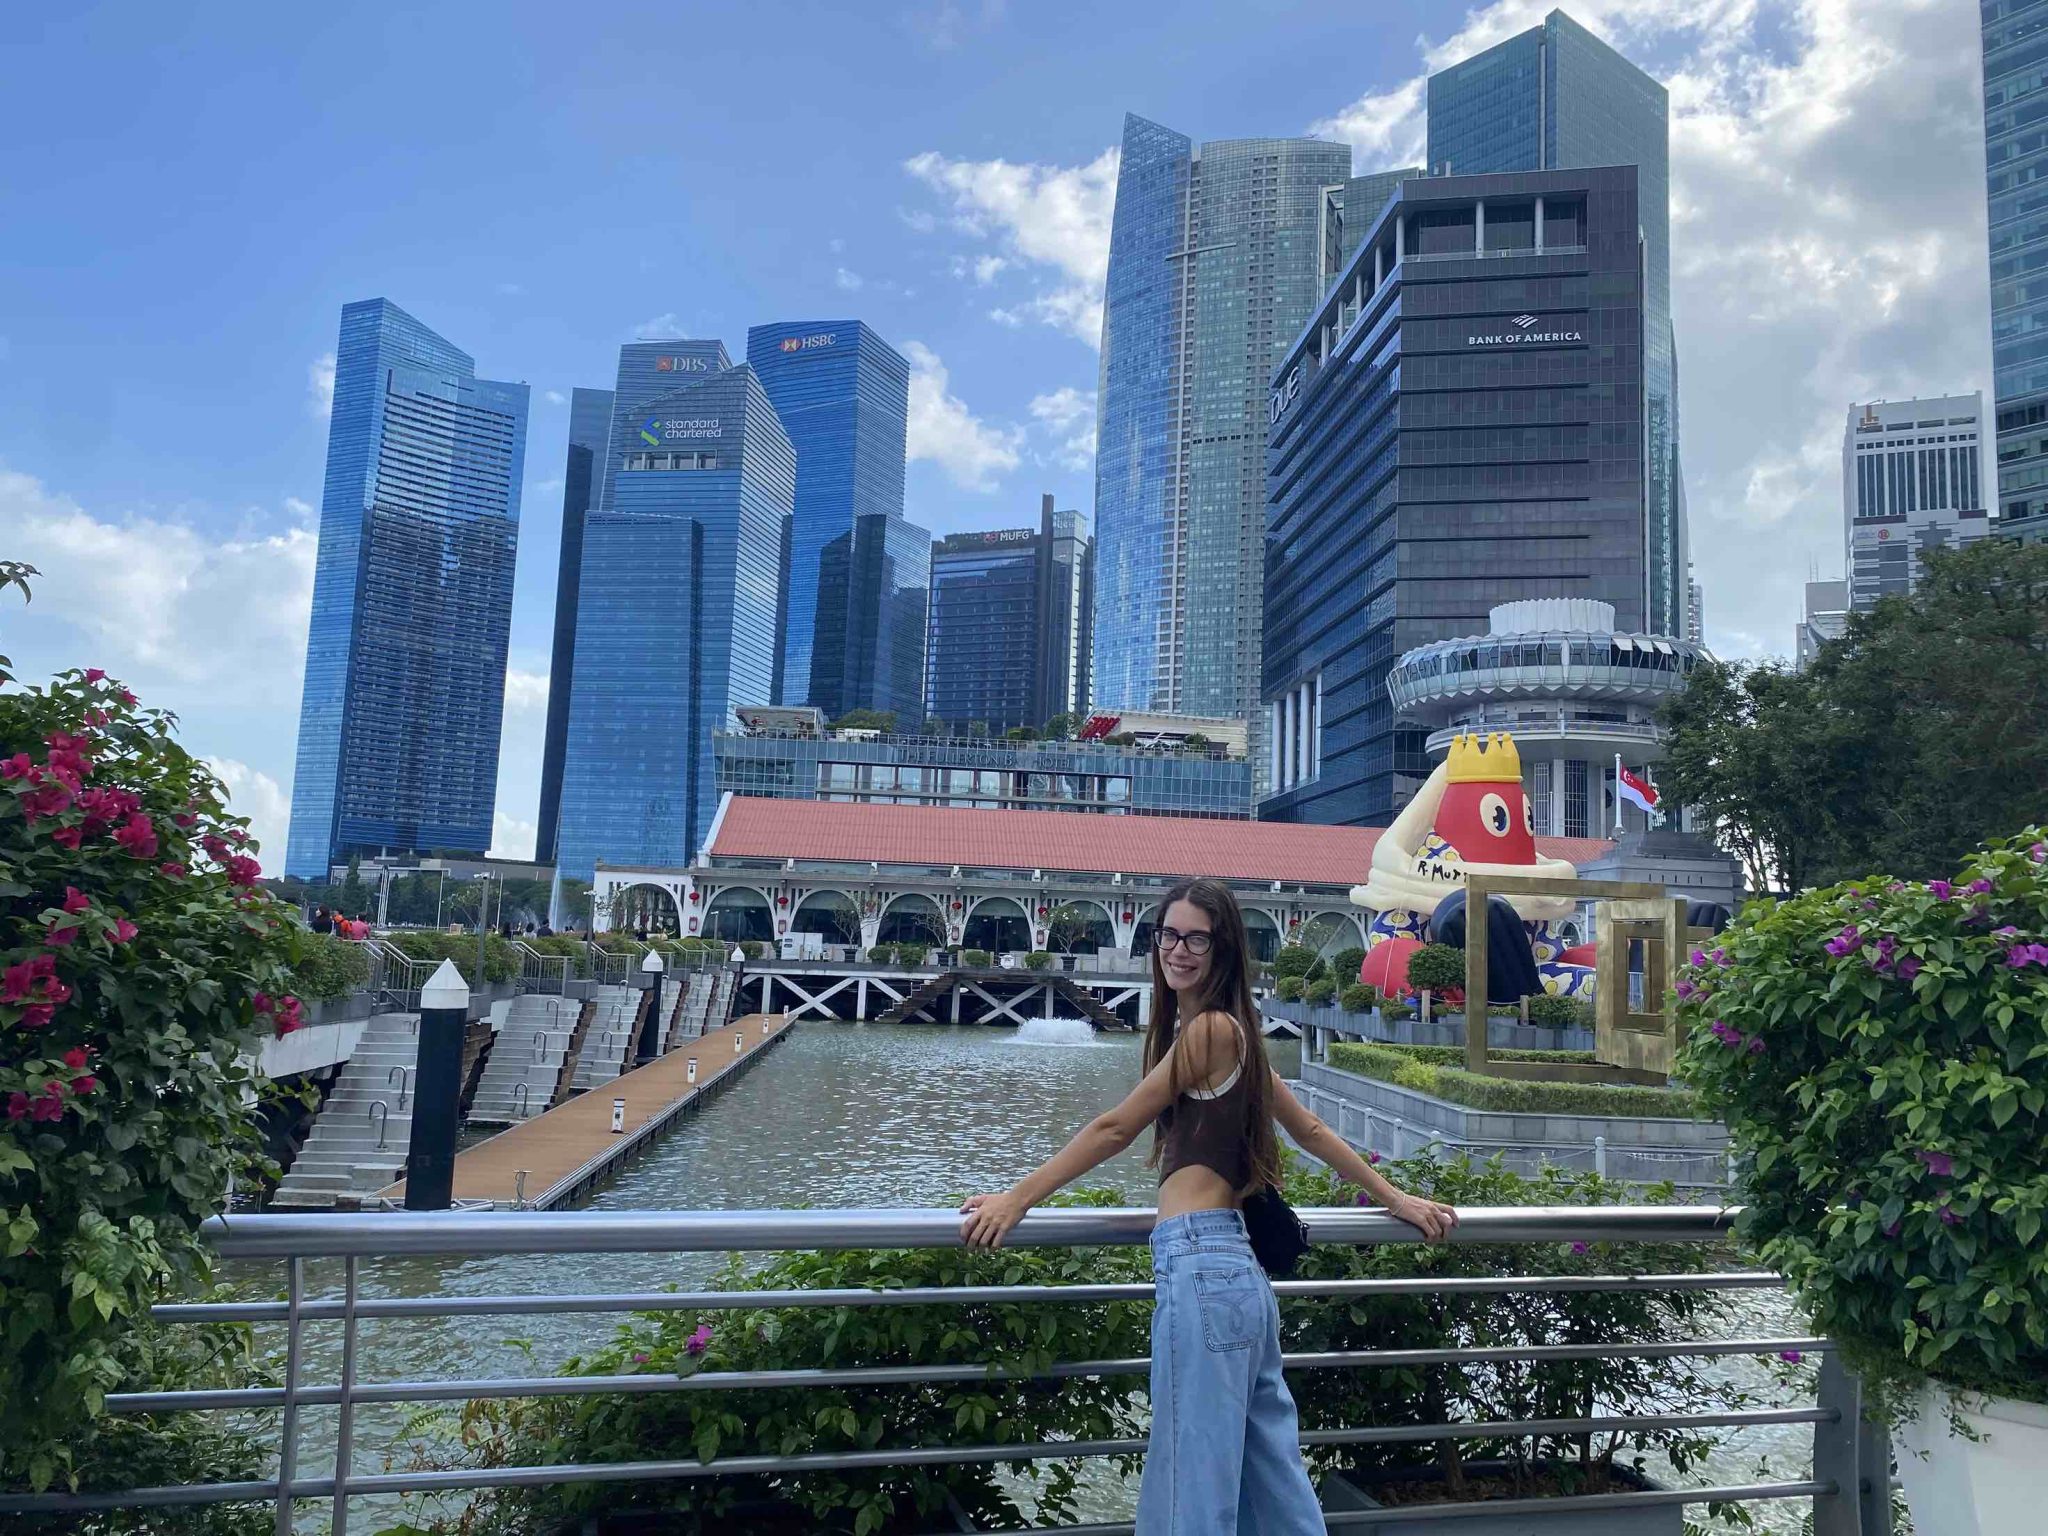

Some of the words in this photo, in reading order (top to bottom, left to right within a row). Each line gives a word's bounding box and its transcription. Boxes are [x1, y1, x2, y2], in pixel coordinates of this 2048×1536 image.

[802, 333, 837, 349] HSBC
[1468, 335, 1502, 345] BANK
[1505, 334, 1522, 343] OF
[1524, 332, 1581, 342] AMERICA
[673, 357, 708, 372] DBS
[665, 418, 719, 429] standard
[665, 428, 722, 439] chartered
[1000, 530, 1030, 542] MUFG
